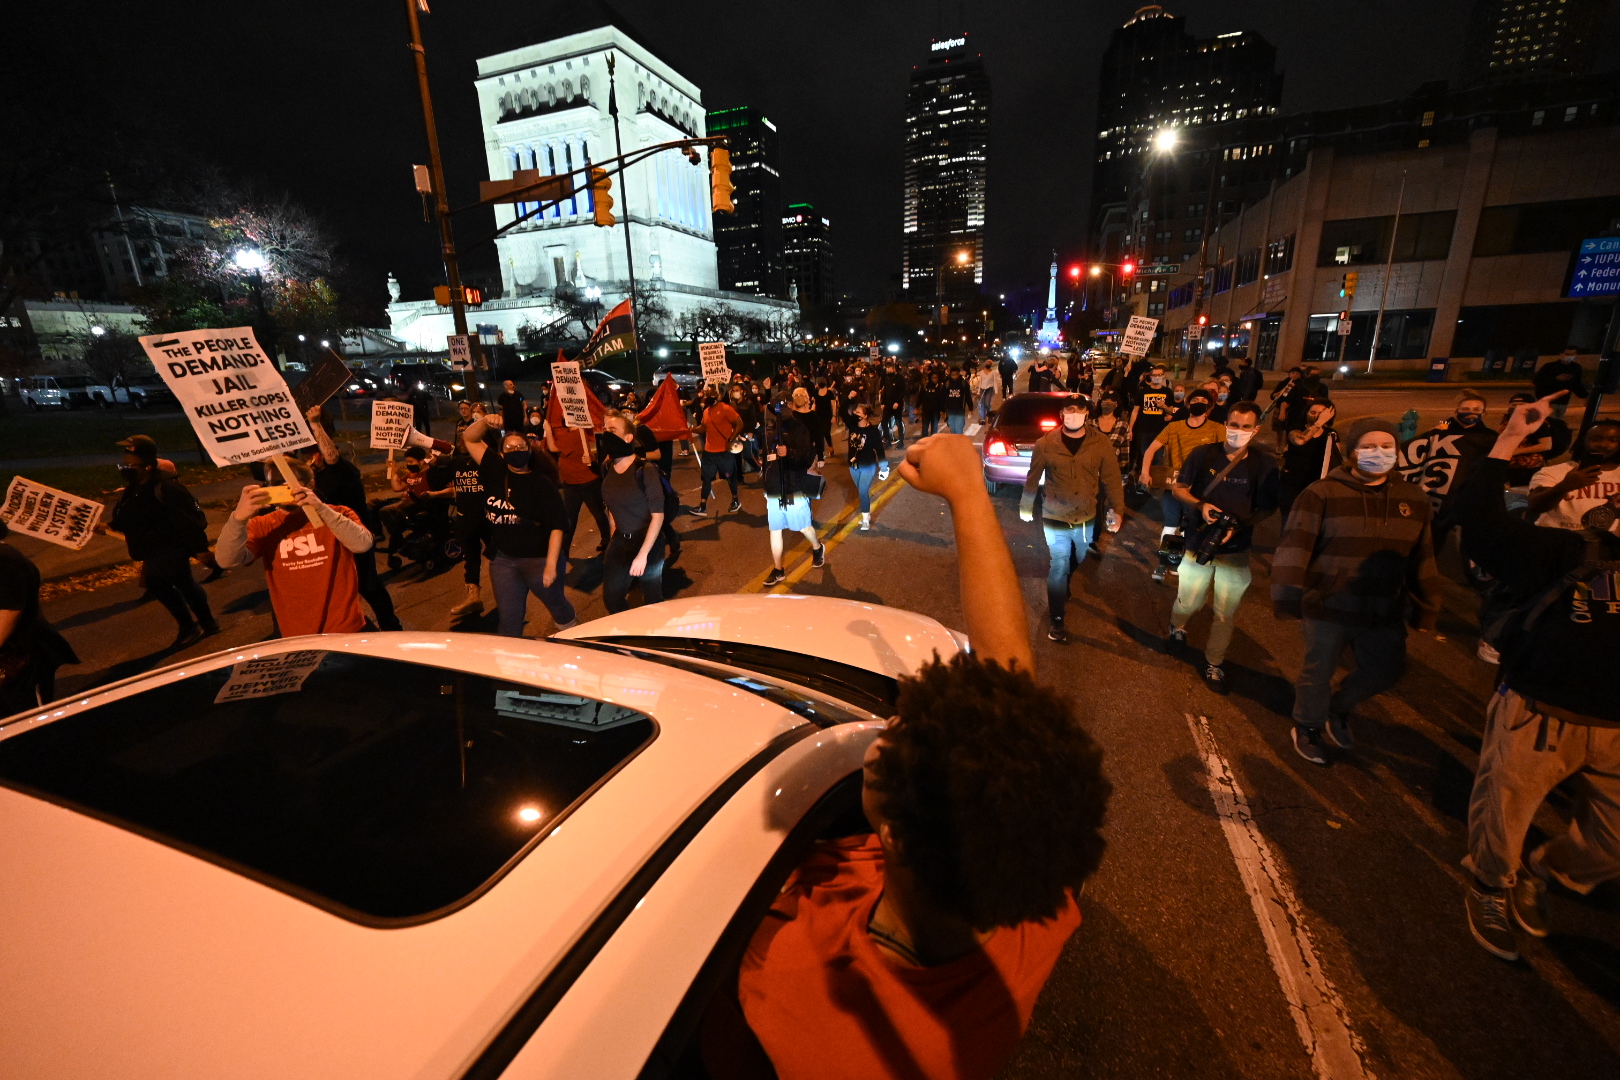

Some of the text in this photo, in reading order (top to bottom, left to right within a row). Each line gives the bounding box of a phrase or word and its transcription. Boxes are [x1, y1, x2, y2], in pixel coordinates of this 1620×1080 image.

[1600, 241, 1620, 250] Can
[163, 337, 254, 359] THE PEOPLE
[450, 338, 466, 346] ONE
[453, 347, 467, 356] WAY
[168, 353, 265, 379] DEMAND:
[212, 374, 257, 395] JAIL
[194, 391, 290, 418] KILLER COPS!
[376, 410, 412, 419] DEMAND:
[388, 405, 411, 413] PEOPLE
[207, 407, 291, 434] NOTHING
[254, 421, 301, 443] LESS!
[1, 481, 28, 521] EMOCRACY
[27, 491, 55, 532] WHOLE NEW
[44, 498, 72, 536] SYSTEM!
[280, 533, 325, 559] PSL
